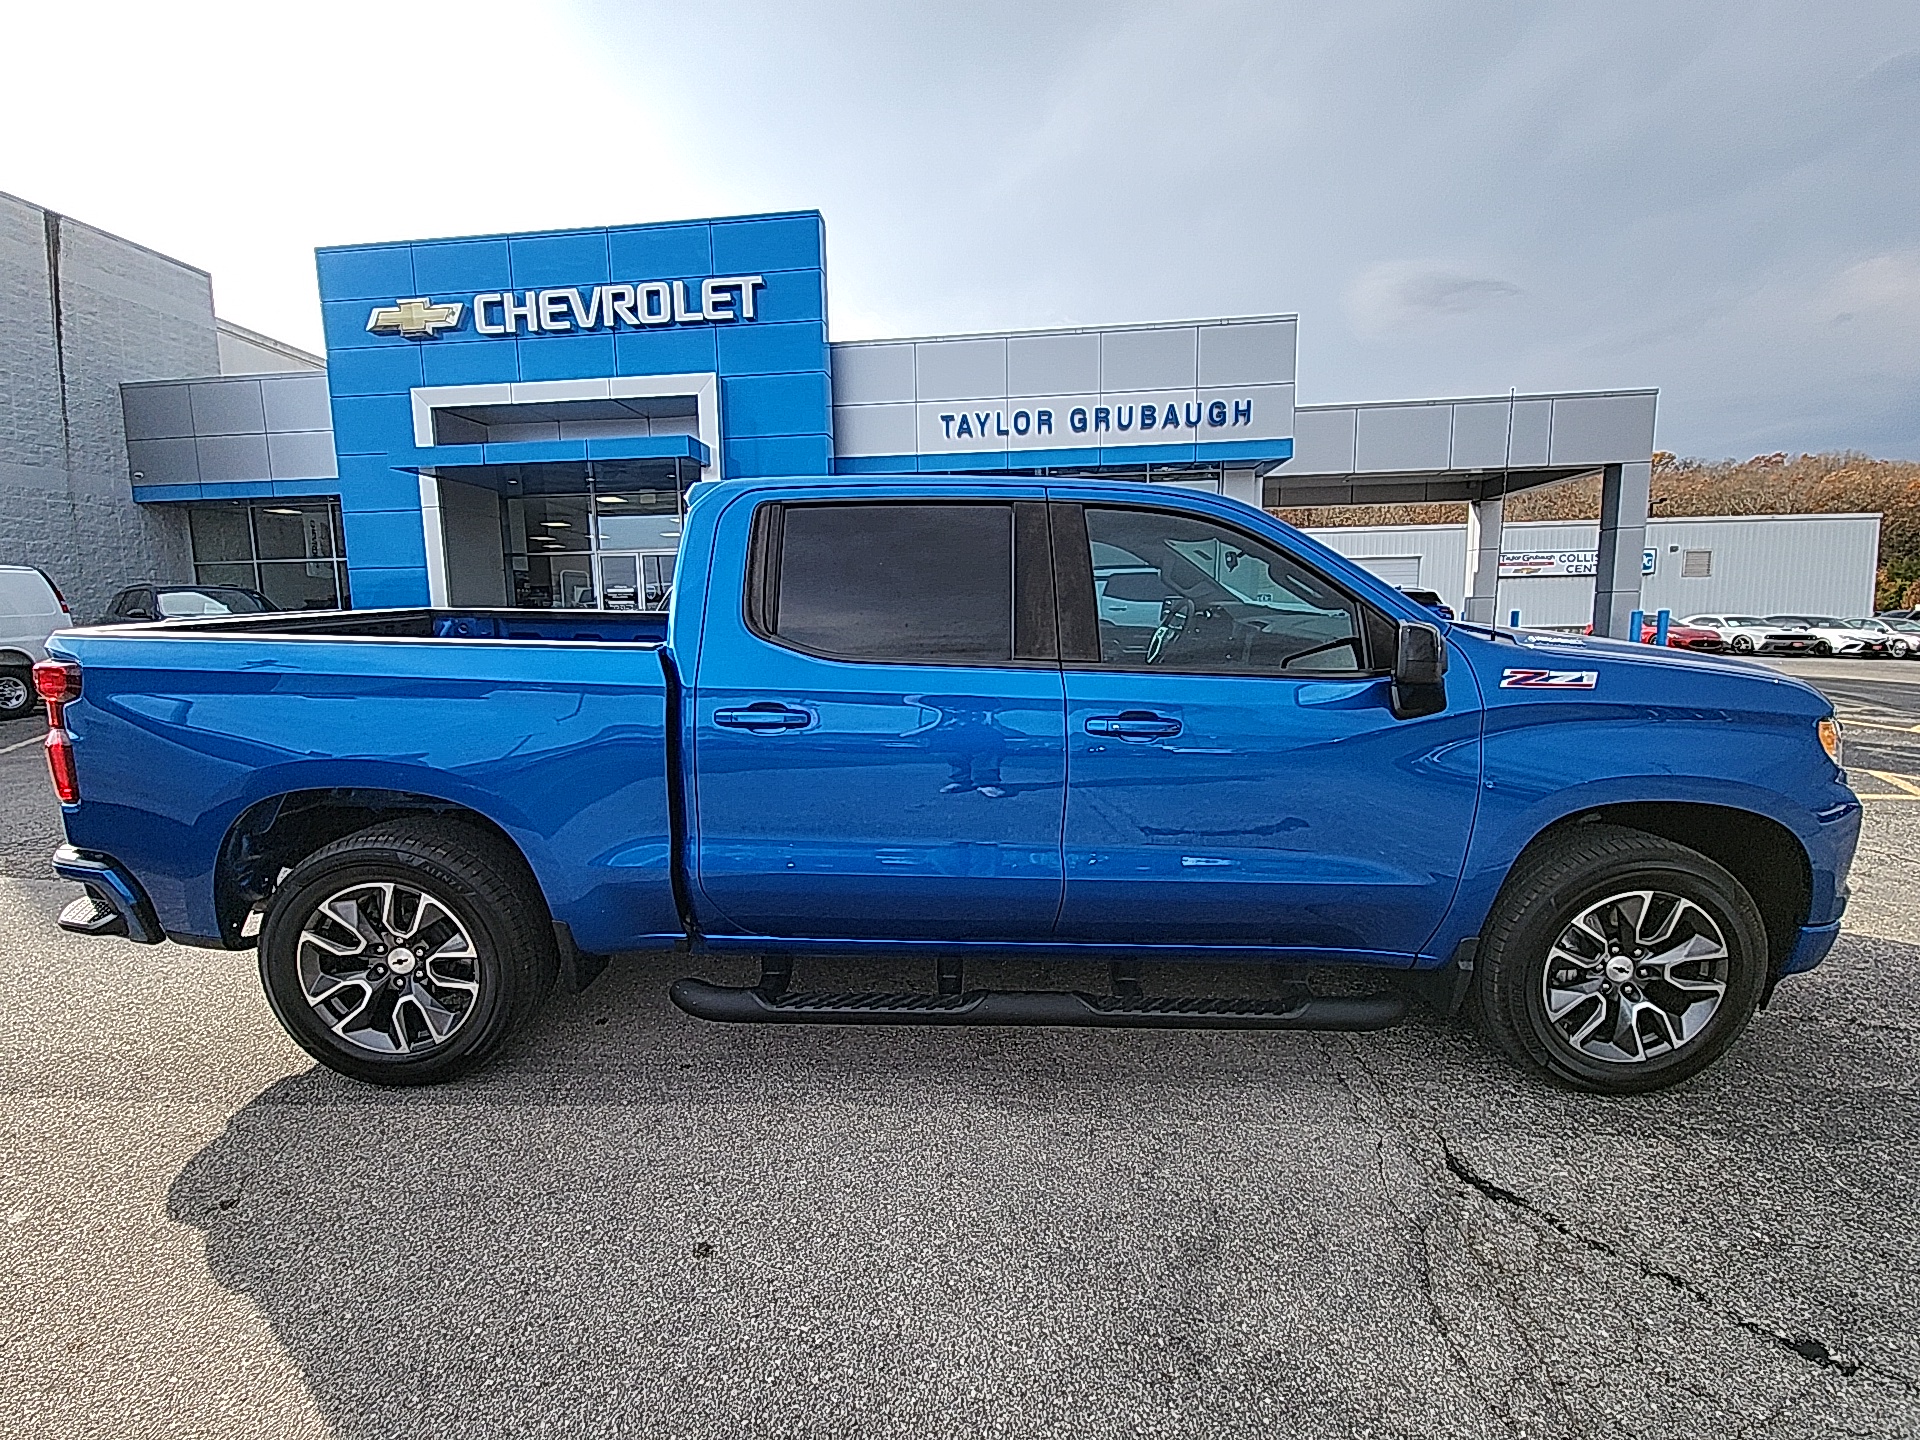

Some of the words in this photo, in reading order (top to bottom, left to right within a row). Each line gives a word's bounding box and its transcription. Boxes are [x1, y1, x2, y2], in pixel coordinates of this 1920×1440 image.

[473, 275, 765, 335] CHEVROLET
[939, 409, 1053, 439] TAYLOR
[1068, 399, 1253, 433] GRUBAUGH
[1500, 668, 1599, 690] Z71
